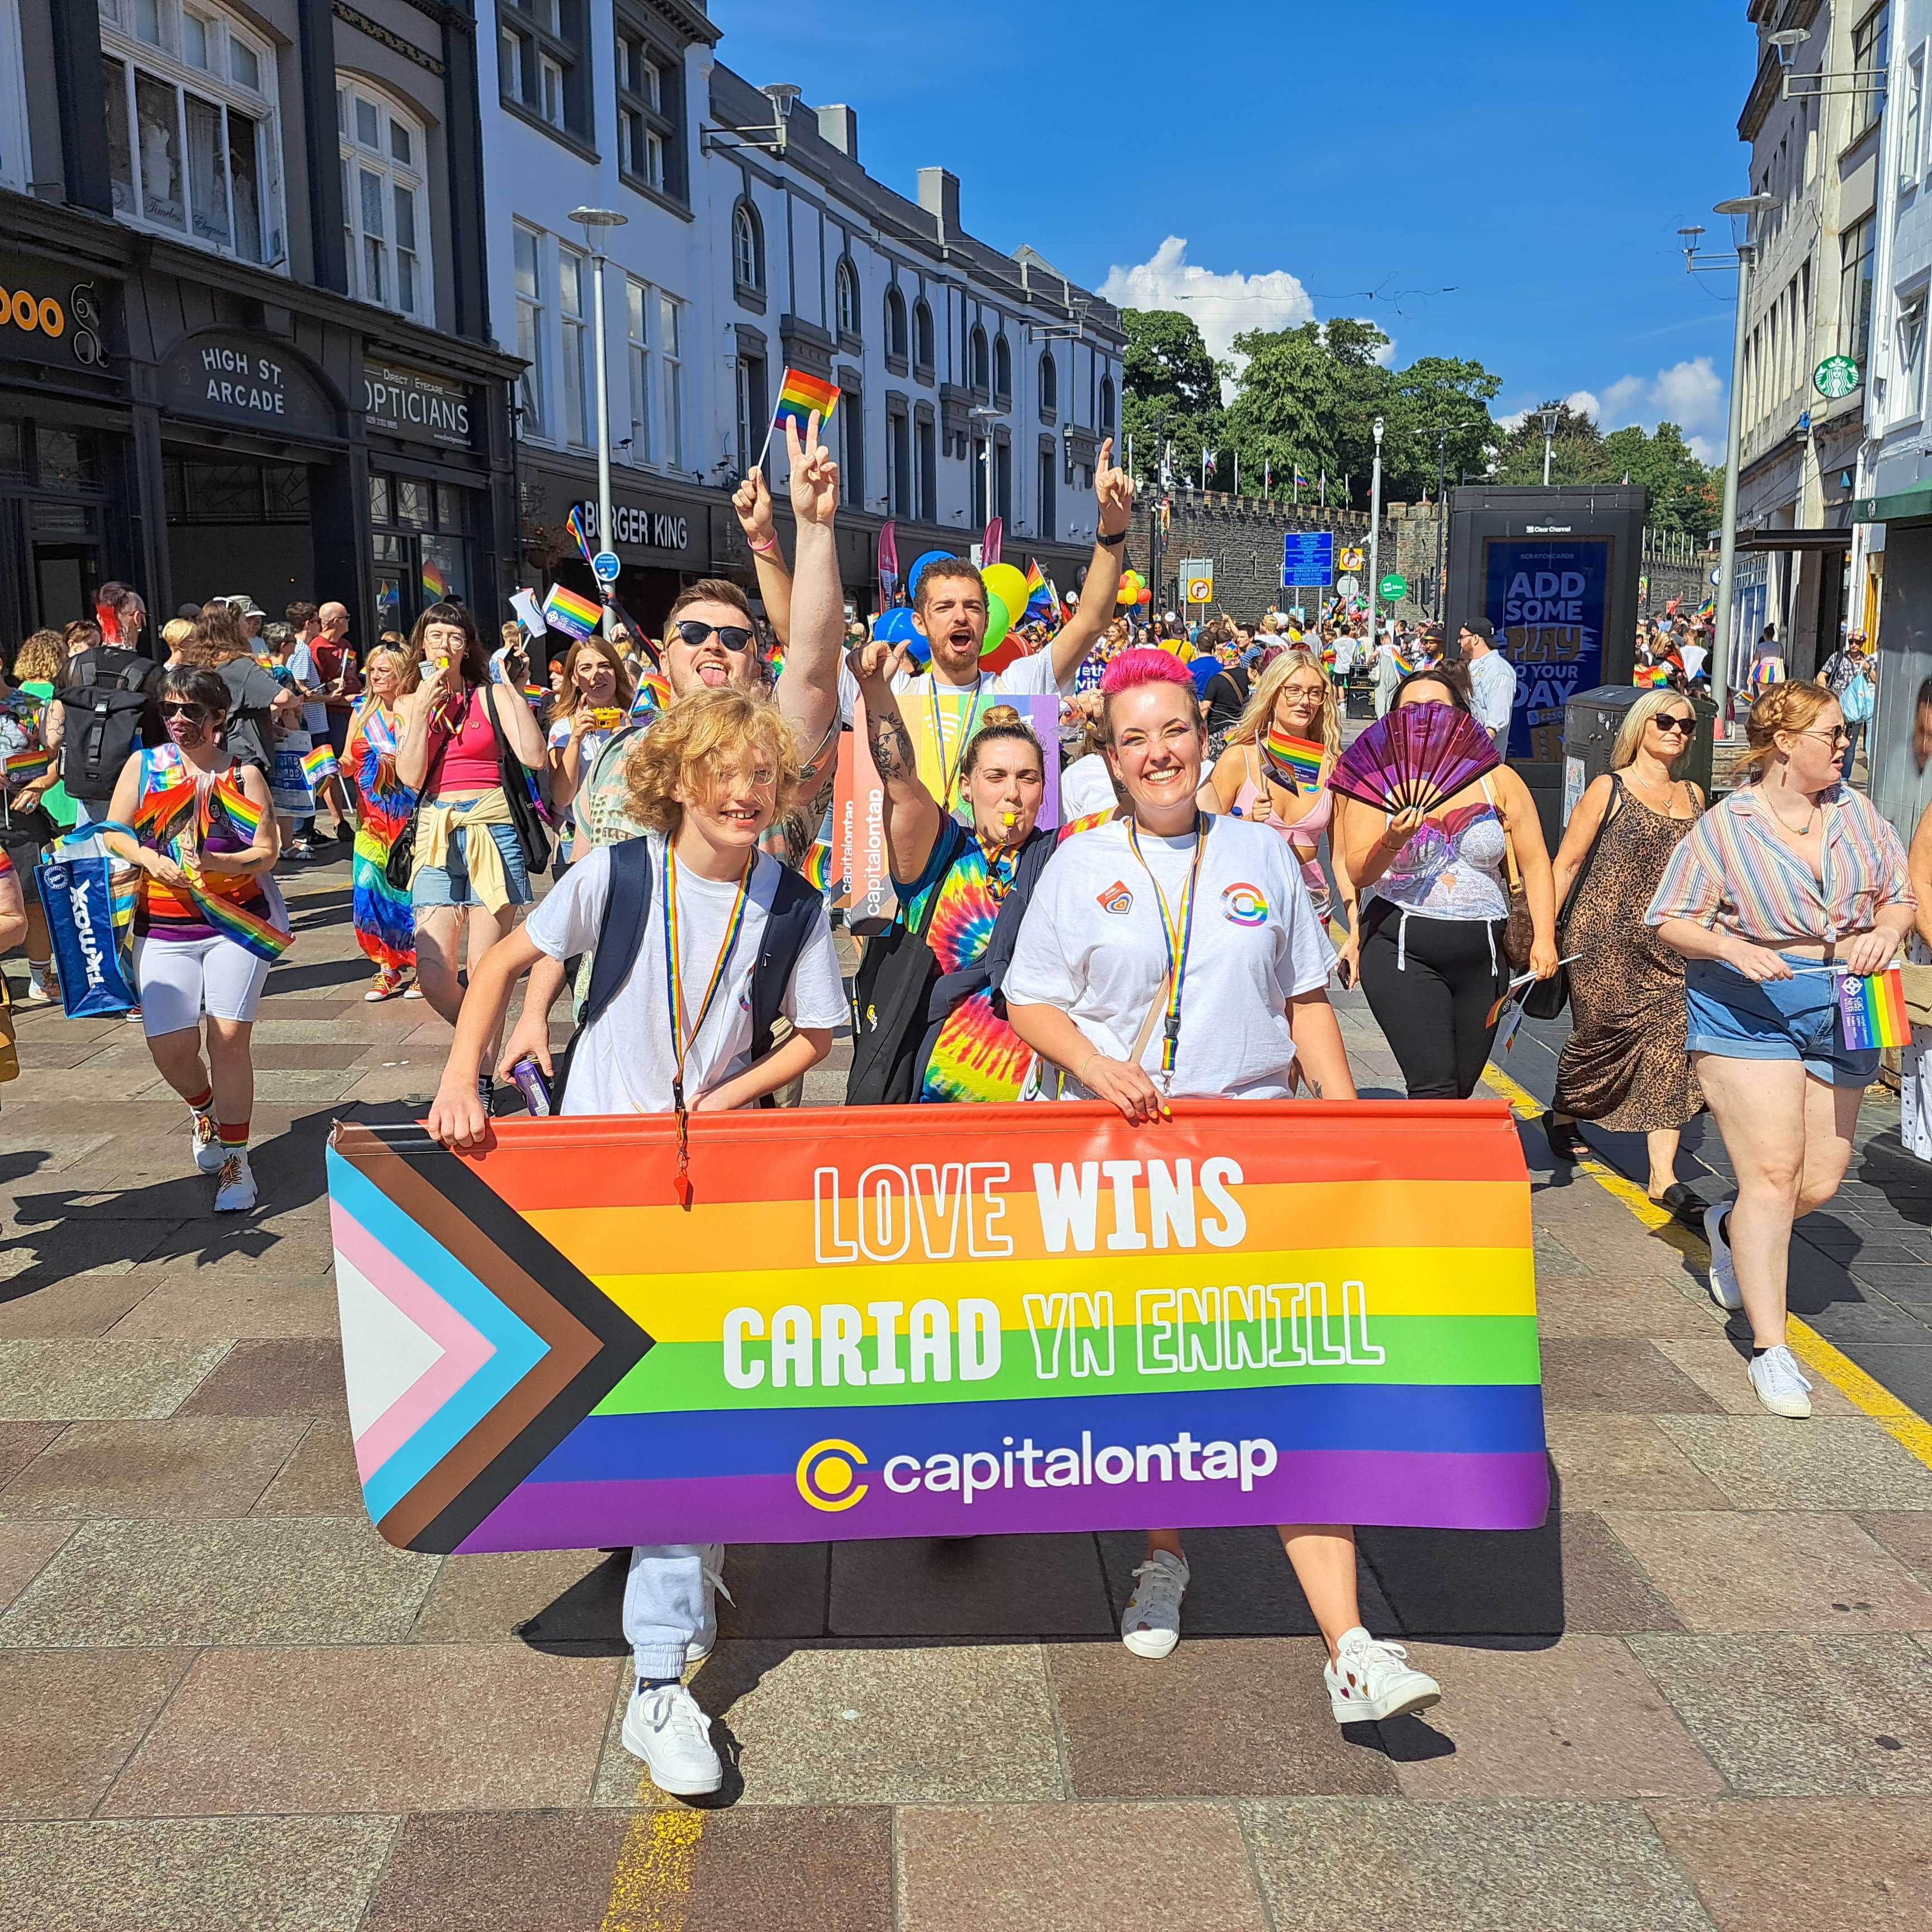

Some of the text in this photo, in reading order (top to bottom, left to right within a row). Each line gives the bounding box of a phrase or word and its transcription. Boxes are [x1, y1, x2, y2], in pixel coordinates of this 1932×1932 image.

[202, 348, 284, 389] HIGH ST.
[207, 379, 285, 414] ARCADE
[655, 513, 688, 550] KING
[1507, 571, 1586, 598] ADD
[1505, 600, 1583, 621] SOME
[1504, 626, 1581, 662] PLAY
[1513, 665, 1579, 678] O YOUR
[866, 788, 883, 917] capitalontap
[814, 1157, 1247, 1263] LOVE WINS
[721, 1280, 1386, 1390] CARIAD YN ENNILL
[882, 1431, 1278, 1504] capitalontap
